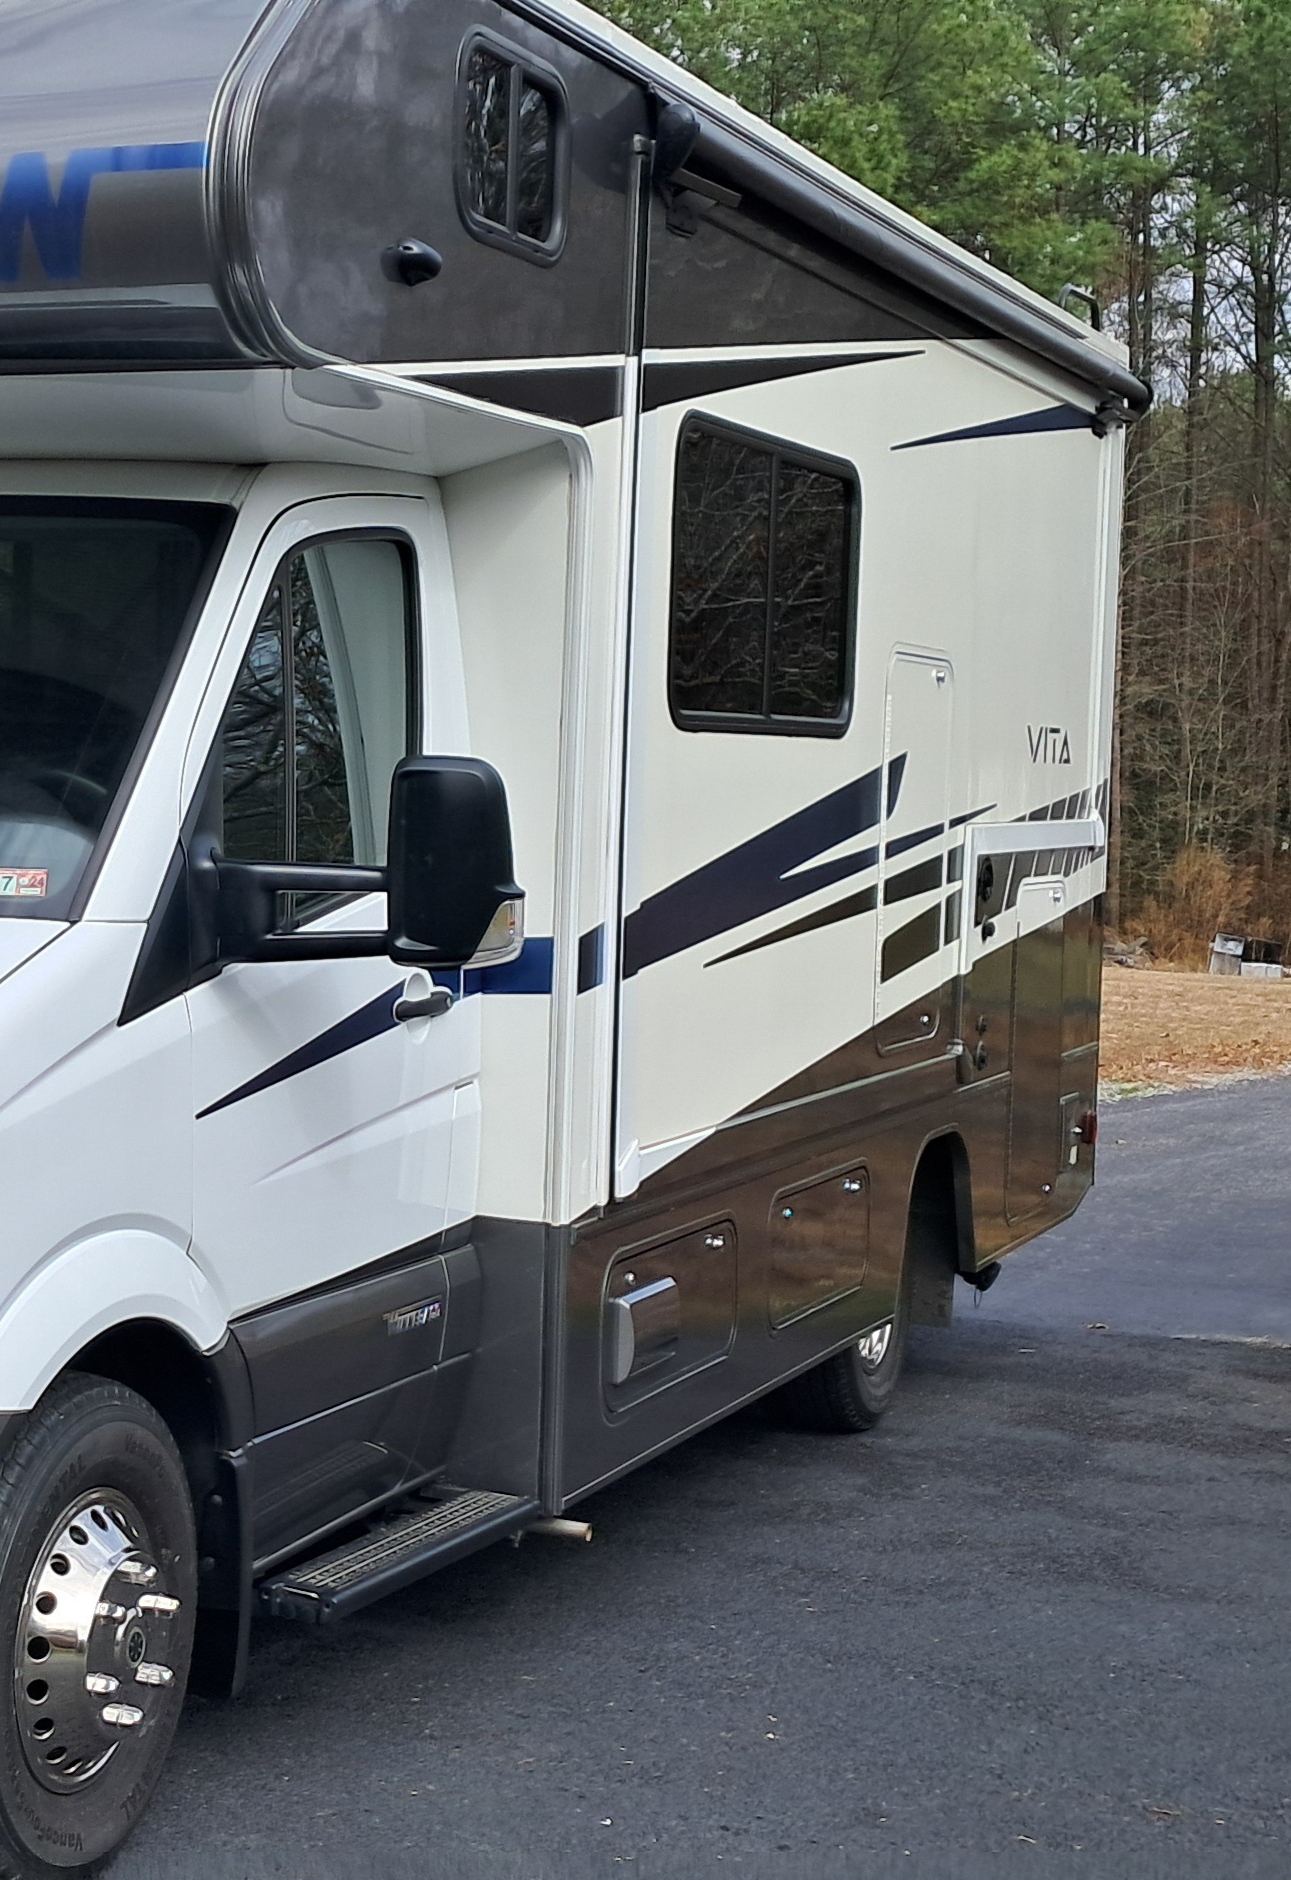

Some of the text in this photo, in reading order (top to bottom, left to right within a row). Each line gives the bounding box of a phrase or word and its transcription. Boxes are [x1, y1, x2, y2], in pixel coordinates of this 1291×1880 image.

[1027, 724, 1071, 764] VITA
[1, 875, 14, 891] 7
[28, 875, 44, 888] 24
